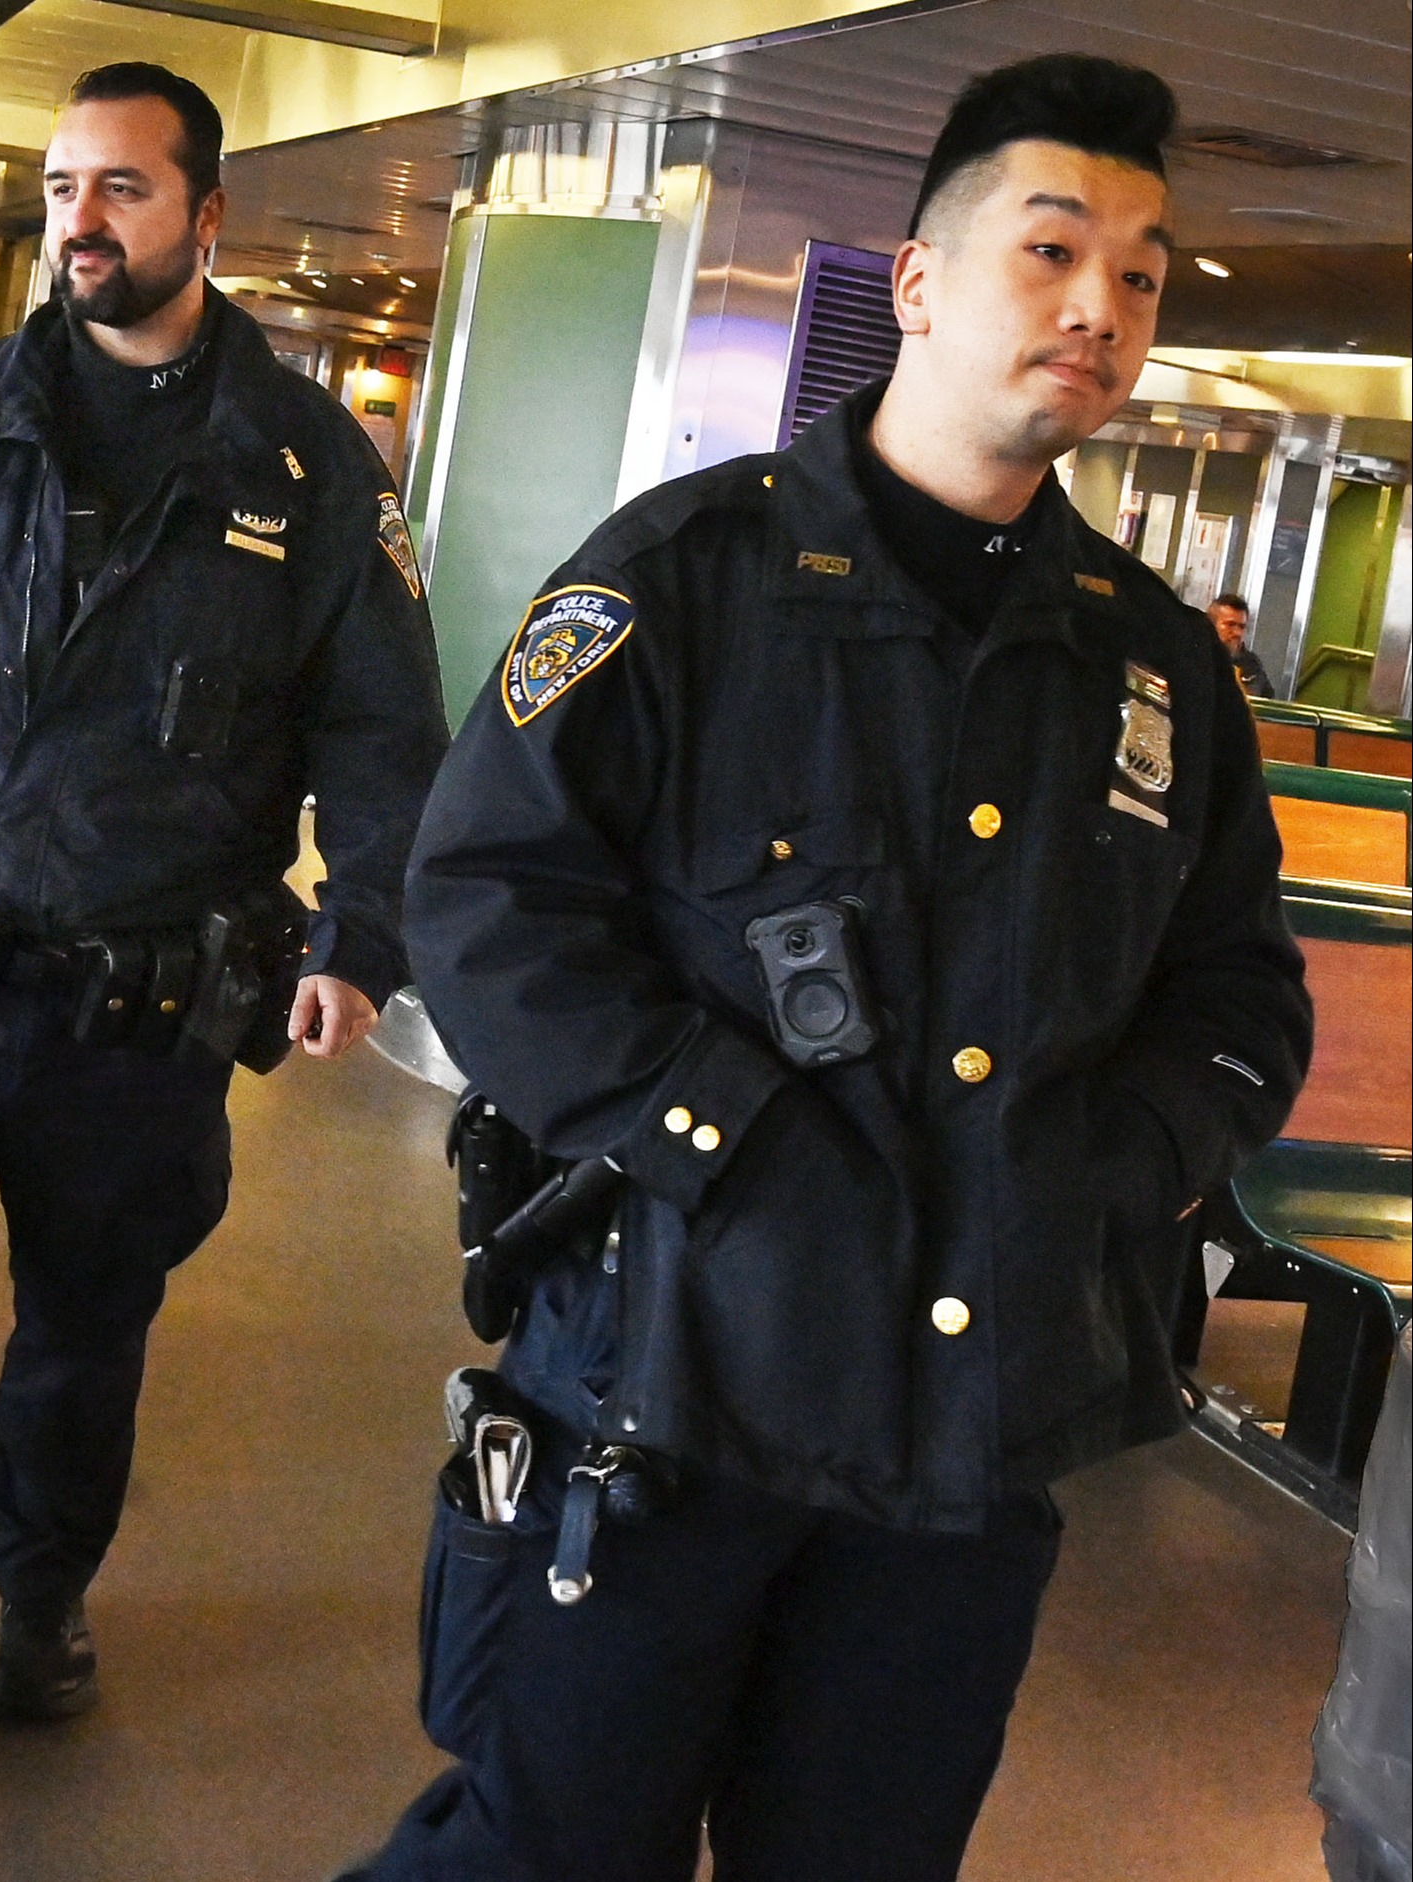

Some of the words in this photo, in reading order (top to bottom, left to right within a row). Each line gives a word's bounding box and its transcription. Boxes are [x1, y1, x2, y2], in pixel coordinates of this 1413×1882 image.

[551, 595, 606, 613] POLICE
[526, 608, 619, 635] DEPARTMENT
[509, 652, 523, 682] CITY
[536, 675, 566, 707] NEW
[566, 641, 610, 675] YORK
[510, 684, 523, 702] OF
